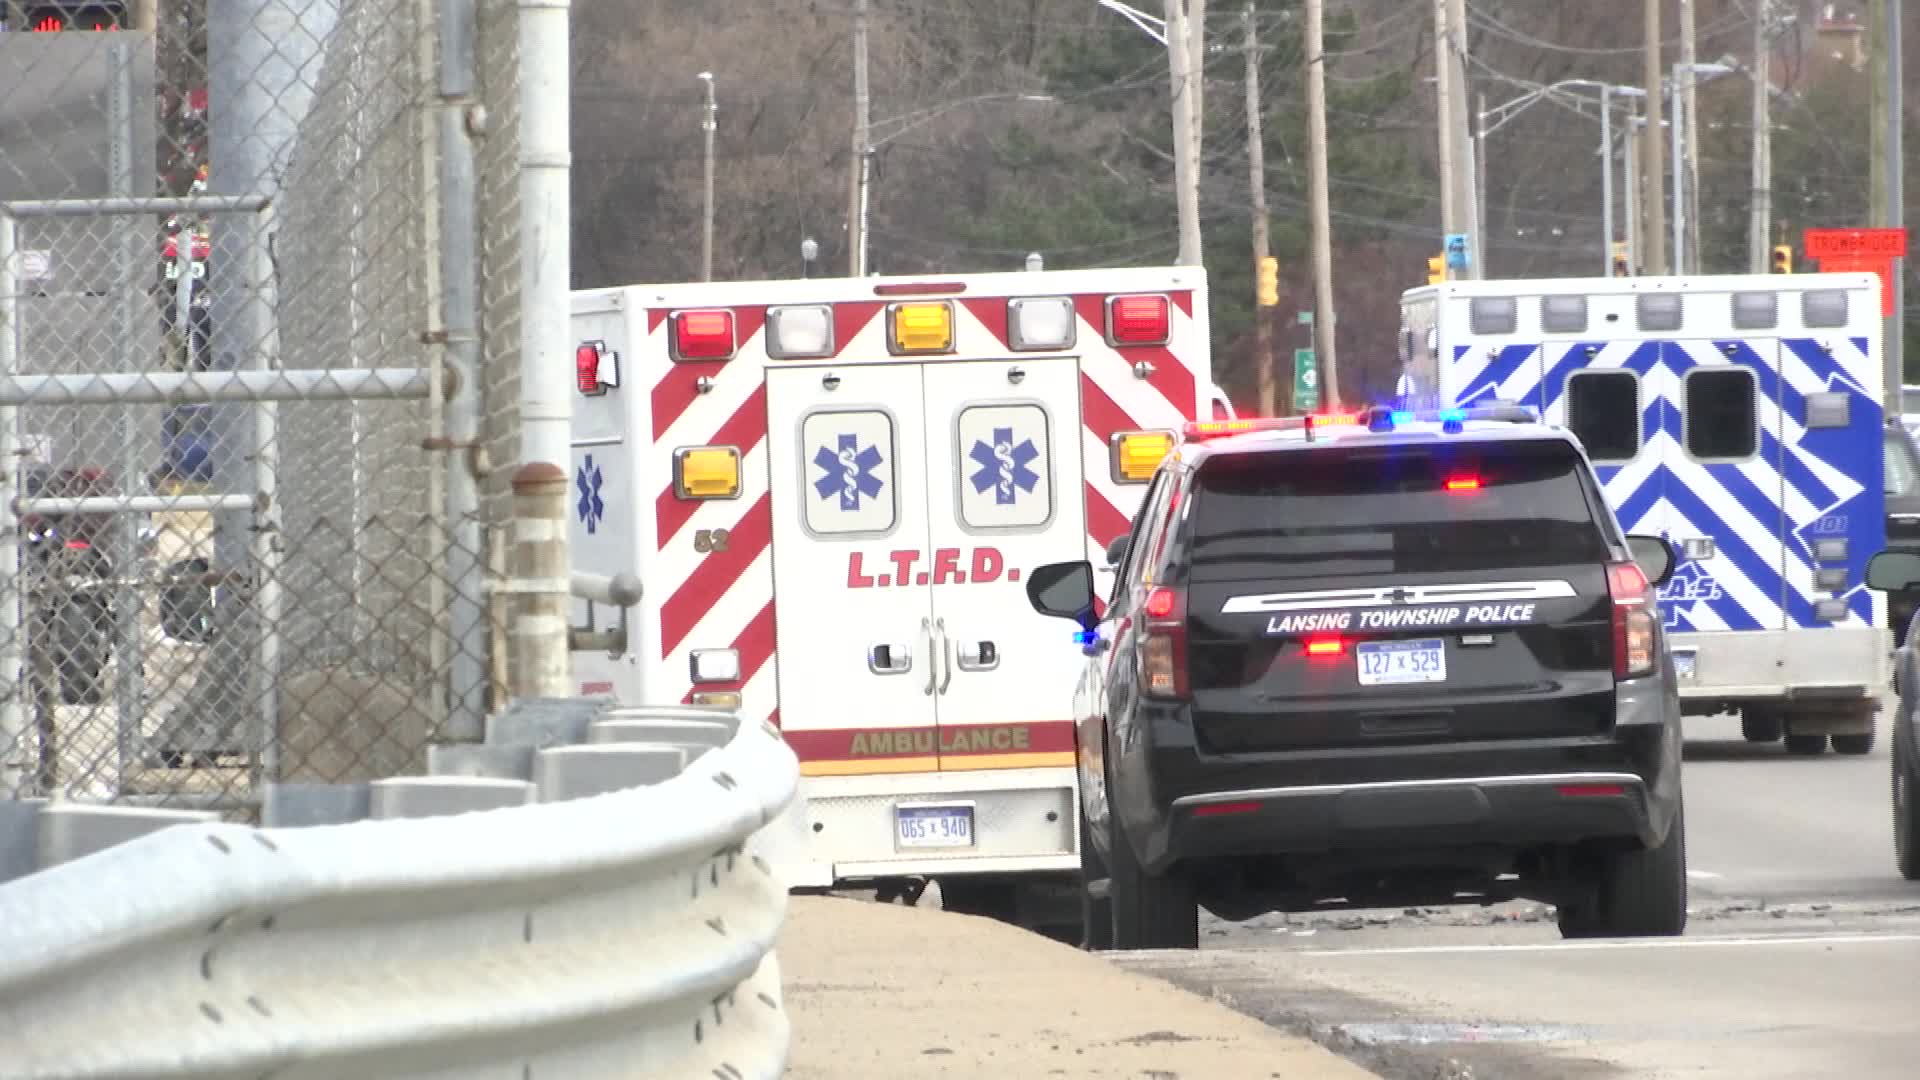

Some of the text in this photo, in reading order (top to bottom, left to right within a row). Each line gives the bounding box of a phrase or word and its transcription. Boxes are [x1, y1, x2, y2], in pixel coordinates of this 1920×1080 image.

[694, 528, 730, 553] 52
[848, 546, 1020, 588] L.T.F.D.
[1266, 604, 1535, 633] LANSING TOWNSHIP POLICE
[1363, 652, 1390, 675] 127
[1411, 651, 1440, 672] 529
[850, 727, 1030, 755] AMBULANCE
[901, 819, 925, 839] 065
[941, 817, 967, 837] 940
